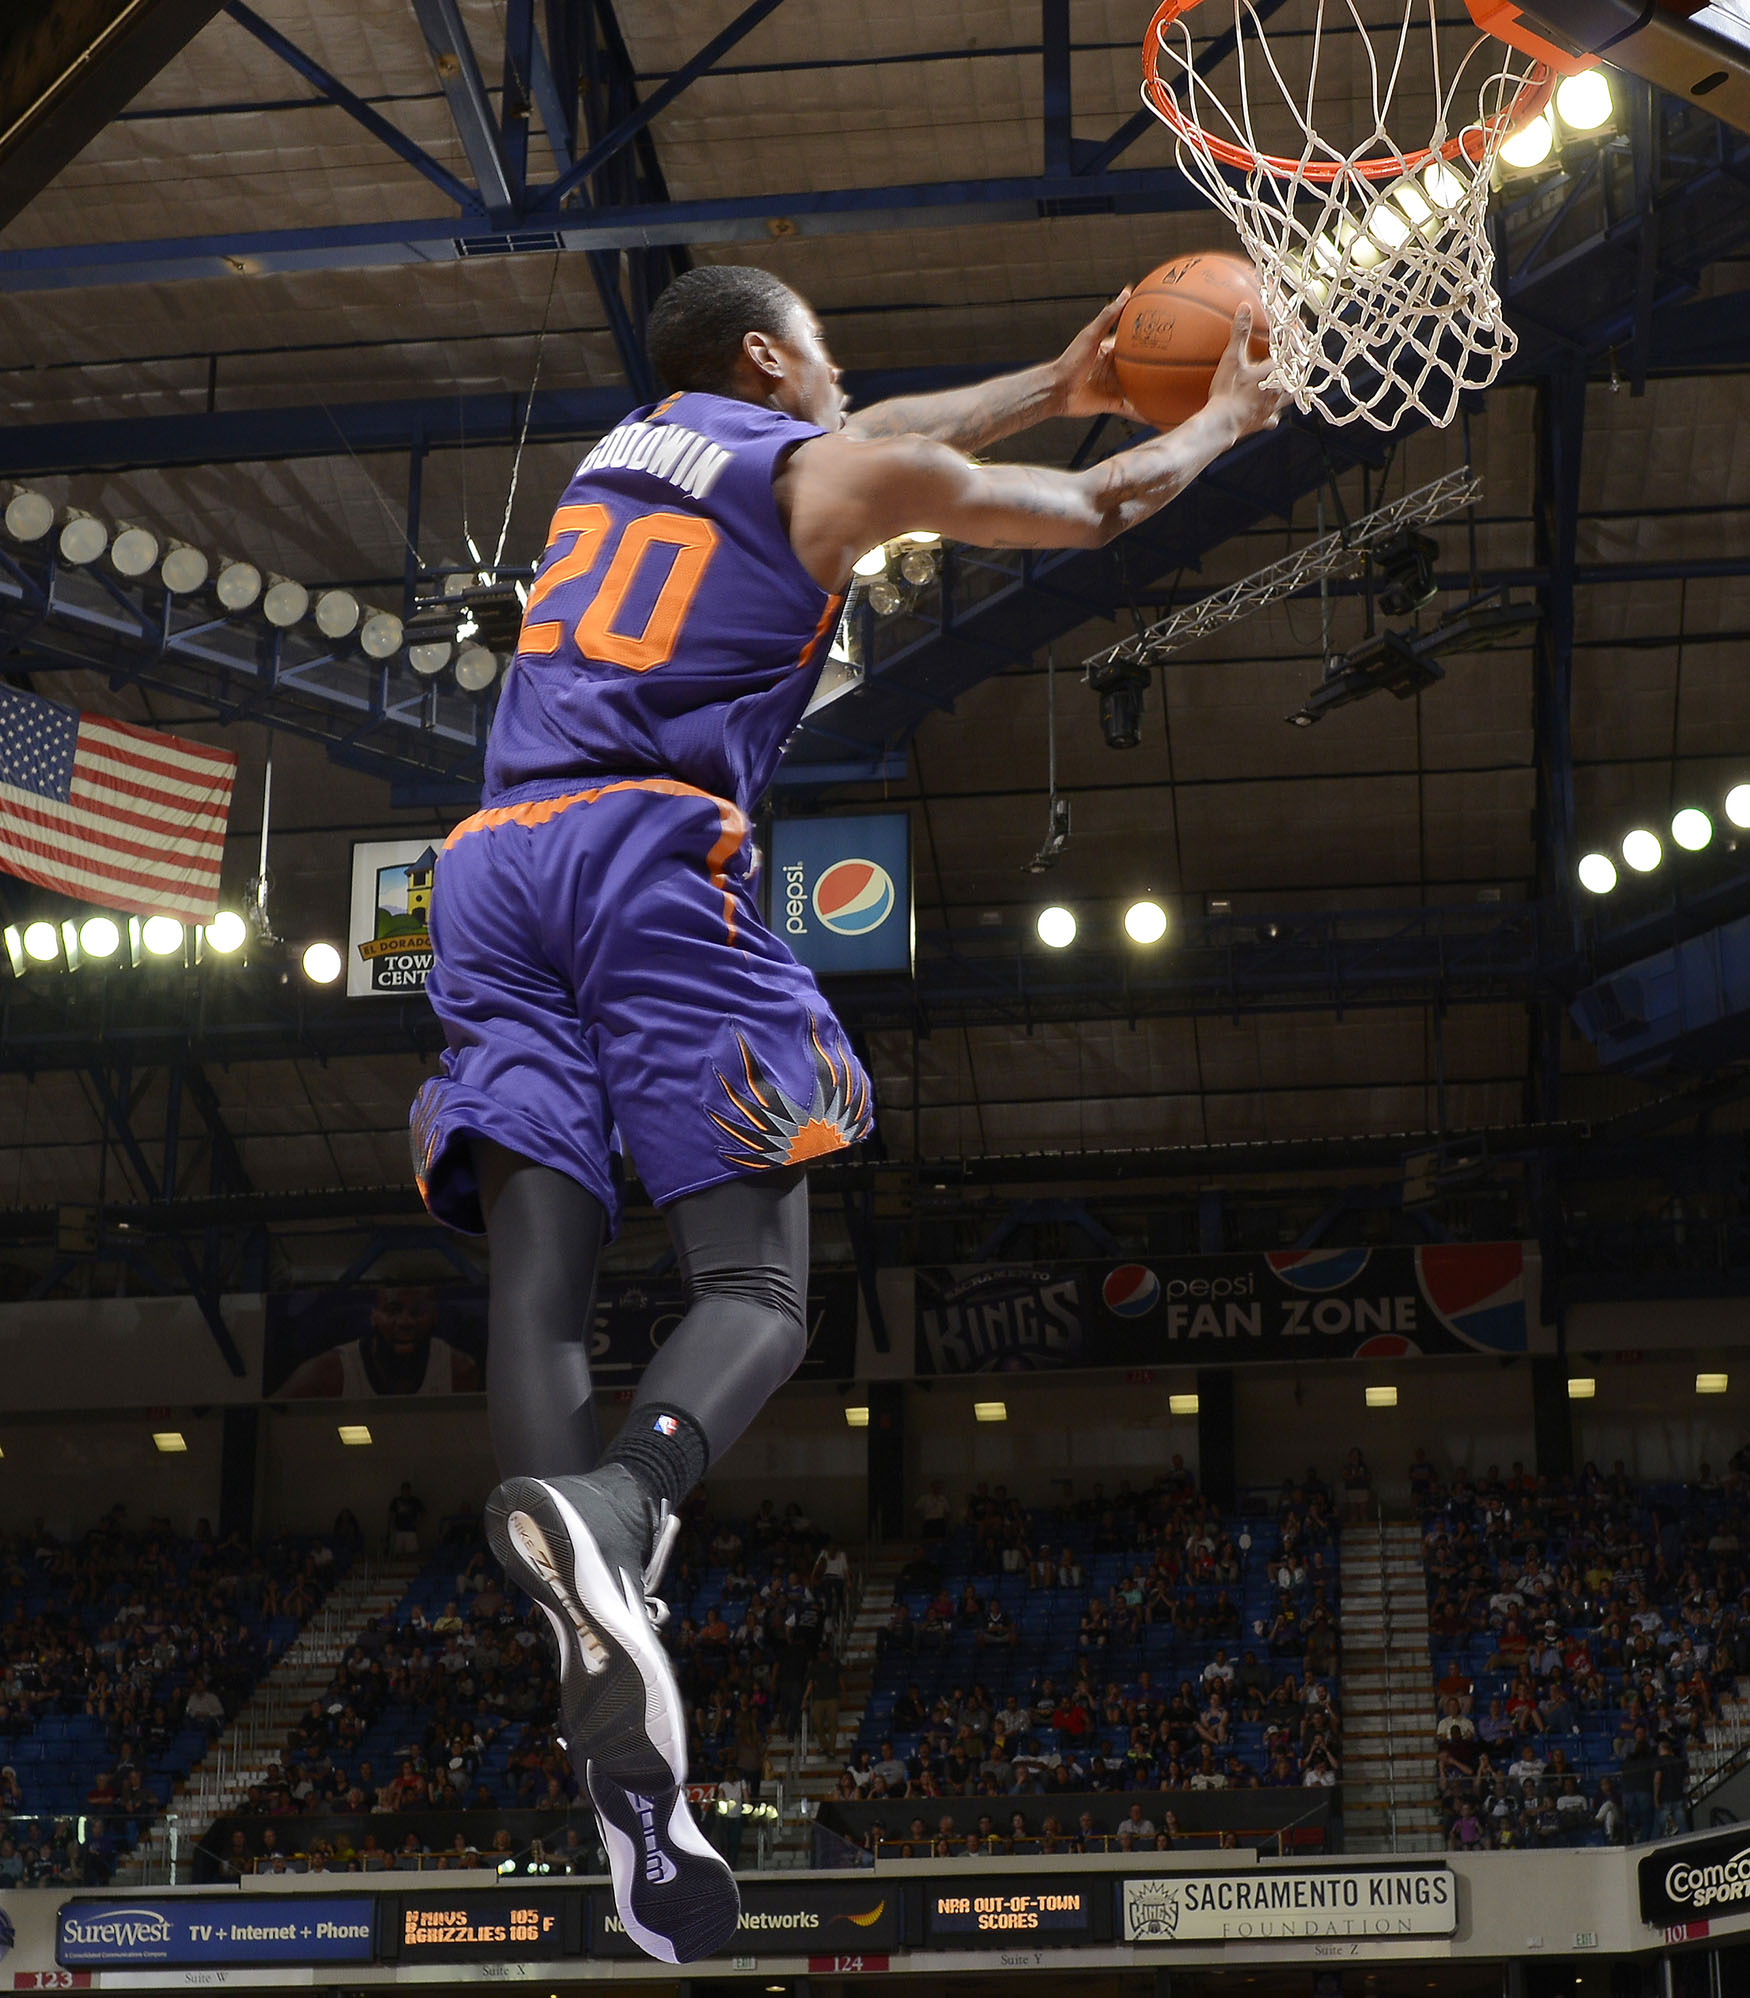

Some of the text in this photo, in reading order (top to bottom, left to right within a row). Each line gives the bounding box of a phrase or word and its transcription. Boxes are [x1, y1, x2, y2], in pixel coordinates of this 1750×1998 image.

[576, 422, 734, 500] GOODWIN
[517, 503, 720, 673] 20
[783, 863, 808, 935] pepsi
[364, 945, 376, 955] EL
[384, 955, 436, 970] TOW
[378, 970, 431, 986] CENT
[1166, 1272, 1255, 1302] pepsi
[922, 1280, 1084, 1373] KINGS
[1167, 1296, 1417, 1340] FAN ZONE
[1185, 1876, 1448, 1911] SACRAMENTO KINGS
[974, 1894, 1081, 1913] OUT-OF-TOWN
[510, 1910, 539, 1924] 105
[542, 1917, 555, 1932] F
[737, 1911, 819, 1929] Networks
[978, 1913, 1039, 1929] SCORES
[63, 1919, 171, 1946] SureWest
[189, 1925, 212, 1941] TV
[231, 1924, 296, 1941] Internet
[316, 1922, 370, 1939] Phone
[416, 1925, 539, 1943] GRIZZLIES 106
[1223, 1918, 1412, 1938] FOUNDATION
[1666, 1924, 1688, 1944] 101
[1001, 1953, 1043, 1965] Suite Y
[1315, 1944, 1359, 1956] Suite Z
[483, 1965, 526, 1977] Suite X
[833, 1955, 864, 1971] 124
[33, 1972, 73, 1989] 123
[185, 1972, 227, 1984] Suite W
